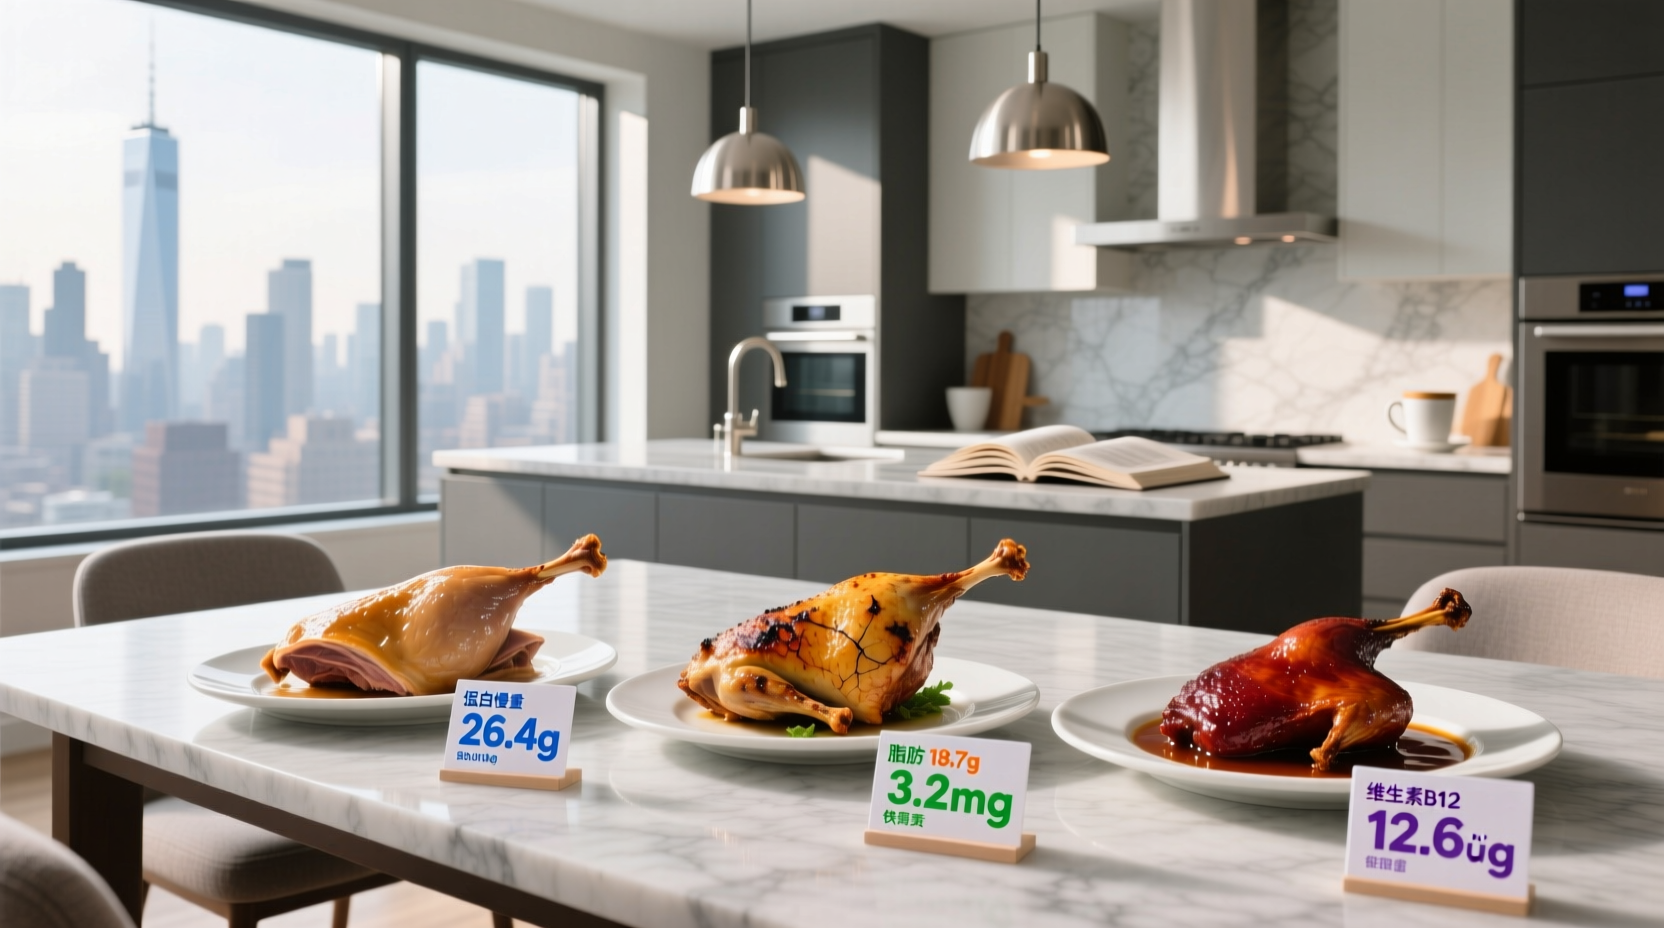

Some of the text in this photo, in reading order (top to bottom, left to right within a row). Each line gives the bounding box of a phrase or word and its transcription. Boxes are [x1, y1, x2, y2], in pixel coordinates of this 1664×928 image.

[458, 712, 560, 762] 26.4g
[888, 744, 981, 775] 脂肪 18.7g
[887, 769, 1013, 829] 3.2mg
[1366, 782, 1460, 809] 维生素B12
